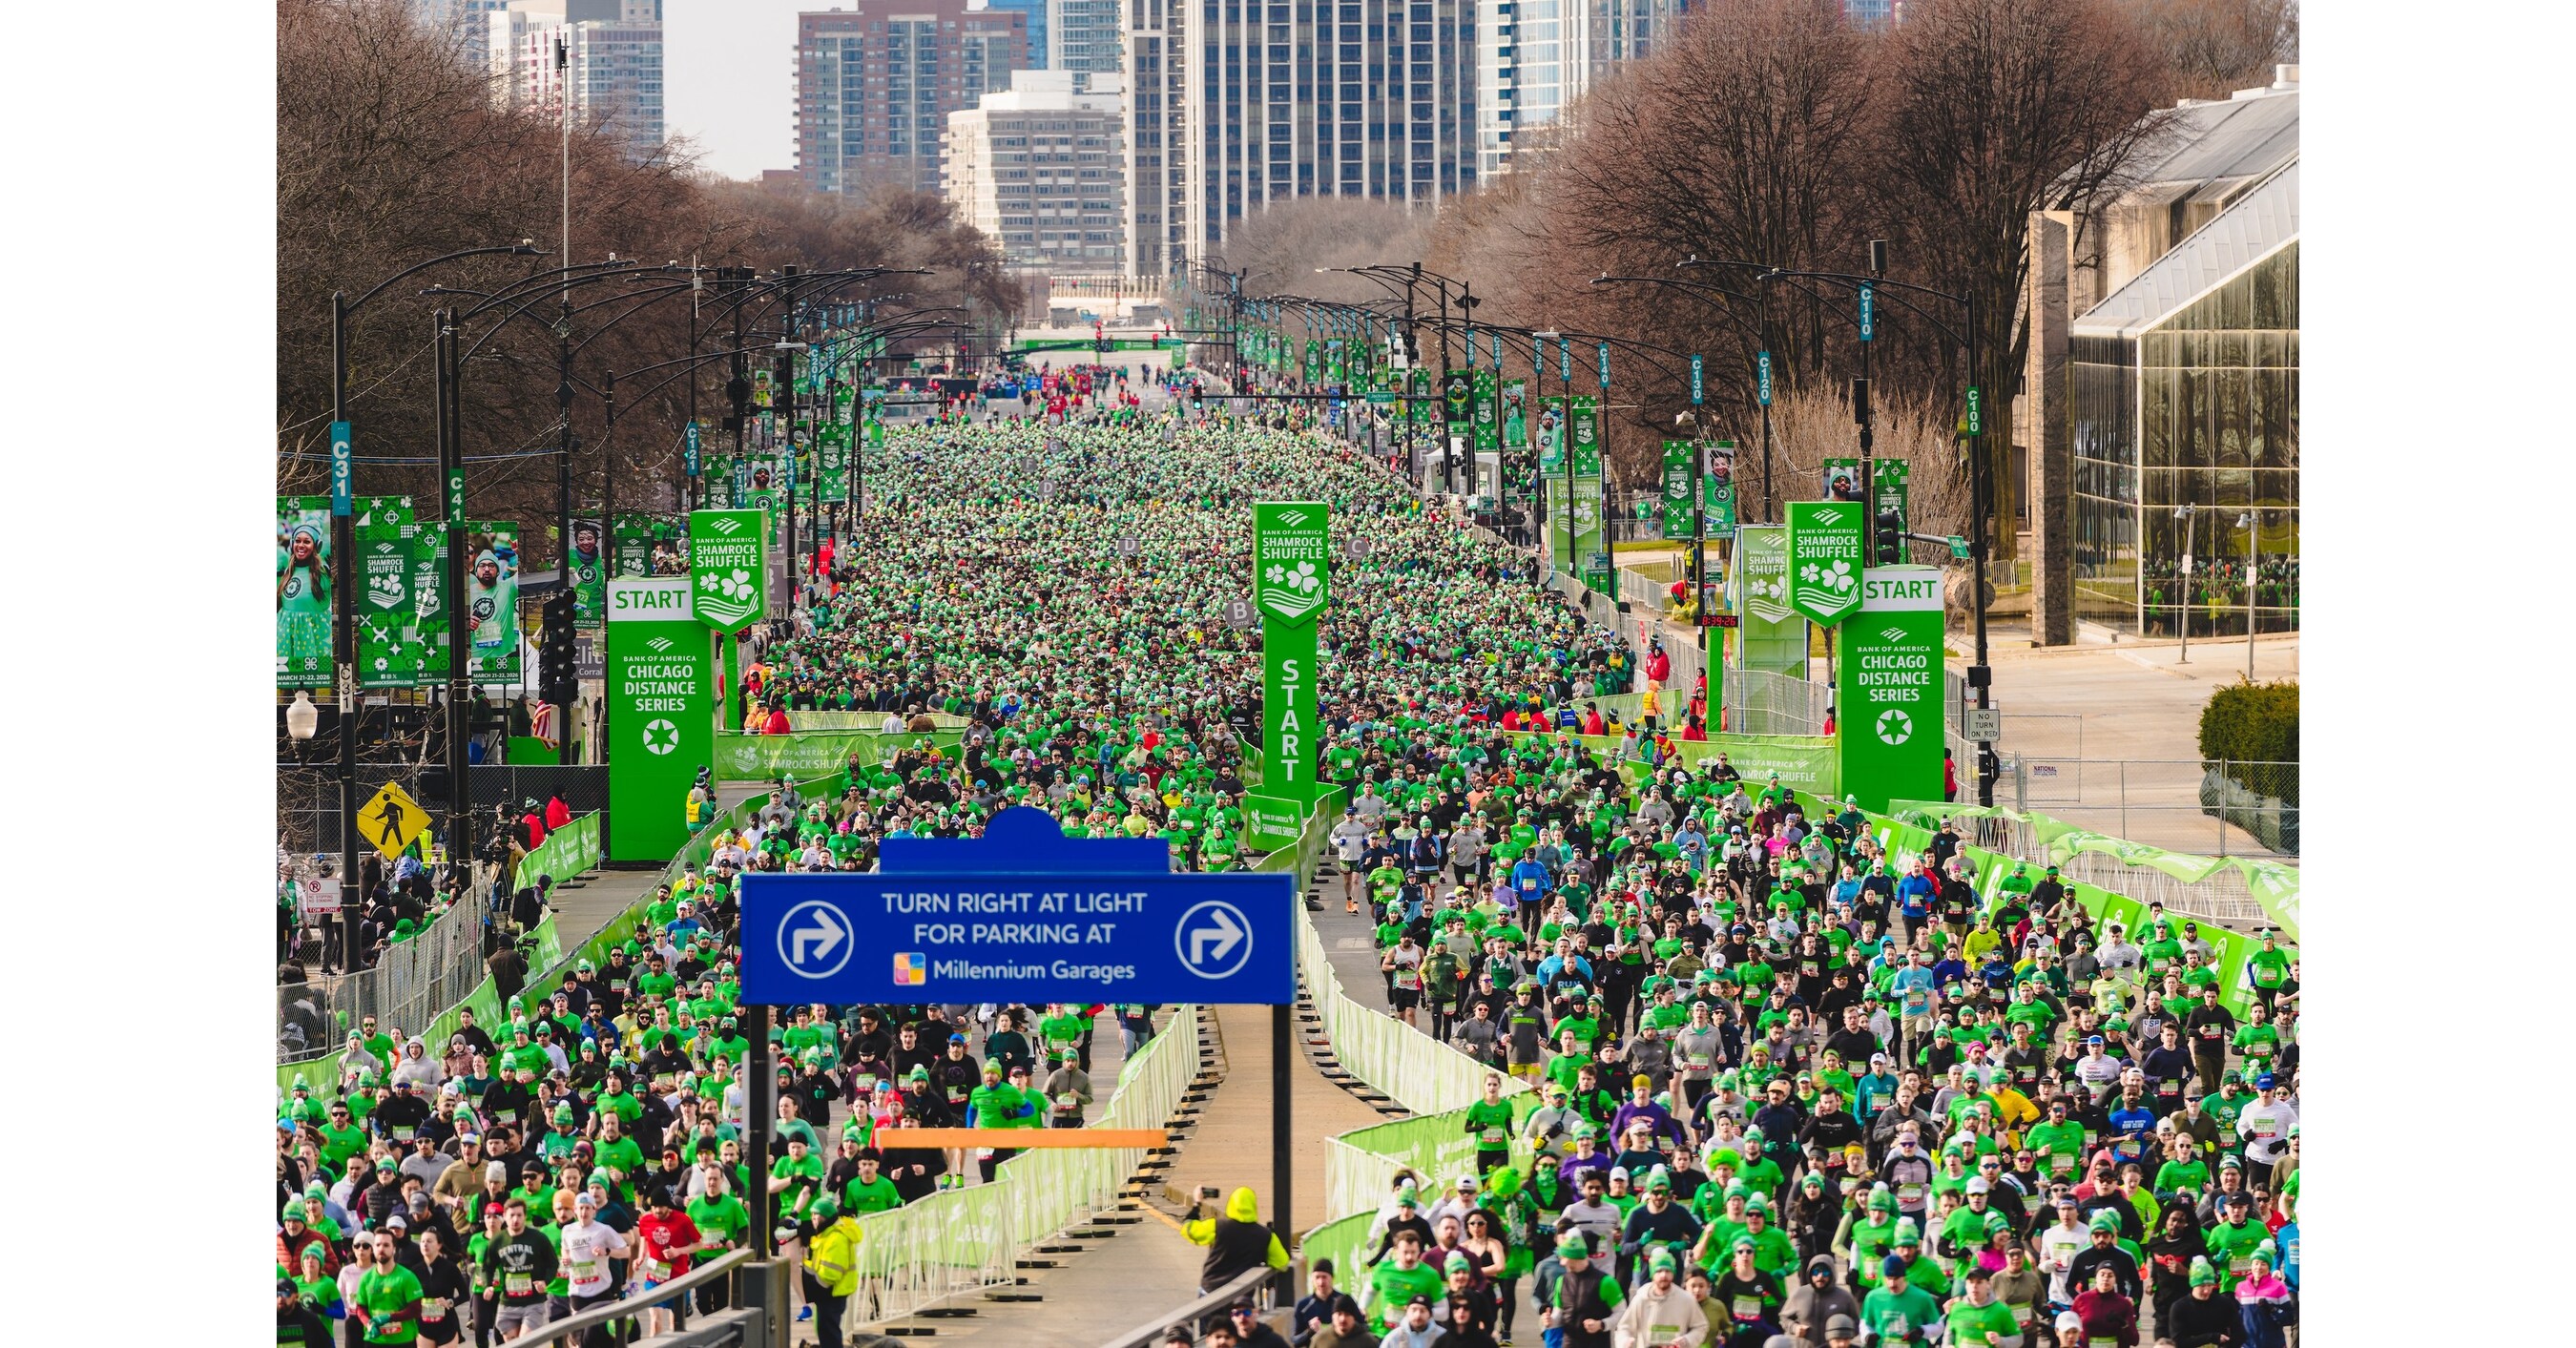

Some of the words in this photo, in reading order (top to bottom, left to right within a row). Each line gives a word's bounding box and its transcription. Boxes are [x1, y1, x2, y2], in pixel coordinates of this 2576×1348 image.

[1861, 289, 1871, 335] C110
[1600, 349, 1608, 383] C140
[1693, 360, 1701, 399] C130
[1760, 358, 1769, 399] C120
[1233, 398, 1244, 407] W
[1968, 390, 1978, 432] C100
[688, 428, 697, 470] C121
[333, 441, 349, 497] C31
[1026, 459, 1033, 468] F
[735, 464, 743, 504] C131
[1043, 483, 1053, 493] D
[287, 498, 300, 509] 45
[451, 477, 463, 521] C41
[481, 522, 492, 531] 45
[1125, 538, 1136, 551] D
[1263, 537, 1323, 547] SHAMROCK
[1351, 540, 1362, 553] C
[1797, 536, 1857, 545] SHAMROCK
[696, 544, 757, 555] SHAMROCK
[1262, 548, 1323, 559] SHUFFLE
[1797, 547, 1858, 558] SHUFFLE
[696, 555, 758, 567] SHUFFLE
[1749, 565, 1785, 574] SHUFF
[1866, 581, 1936, 599] START
[615, 590, 686, 609] START
[1233, 602, 1247, 619] B
[1862, 655, 1927, 668] CHICAGO
[628, 665, 693, 678] CHICAGO
[1859, 672, 1930, 685] DISTANCE
[341, 668, 351, 709] C31
[625, 682, 696, 695] DISTANCE
[1870, 688, 1920, 701] SERIES
[636, 698, 685, 711] SERIES
[1280, 659, 1300, 781] START
[814, 759, 849, 769] SHUFFL
[1779, 772, 1816, 781] SHUFFLE
[1262, 824, 1282, 835] SHAMROCK
[1283, 826, 1298, 838] SHUFFLE
[882, 893, 949, 913] TURN
[958, 893, 1033, 913] RIGHT
[1039, 893, 1070, 913] AT
[1076, 893, 1147, 913] LIGHT
[915, 924, 966, 944] FOR
[973, 924, 1079, 944] PARKING
[1085, 924, 1115, 944] AT
[934, 960, 1045, 979] Millennium
[1051, 961, 1134, 983] Garages
[498, 1244, 533, 1258] CENTRAL
